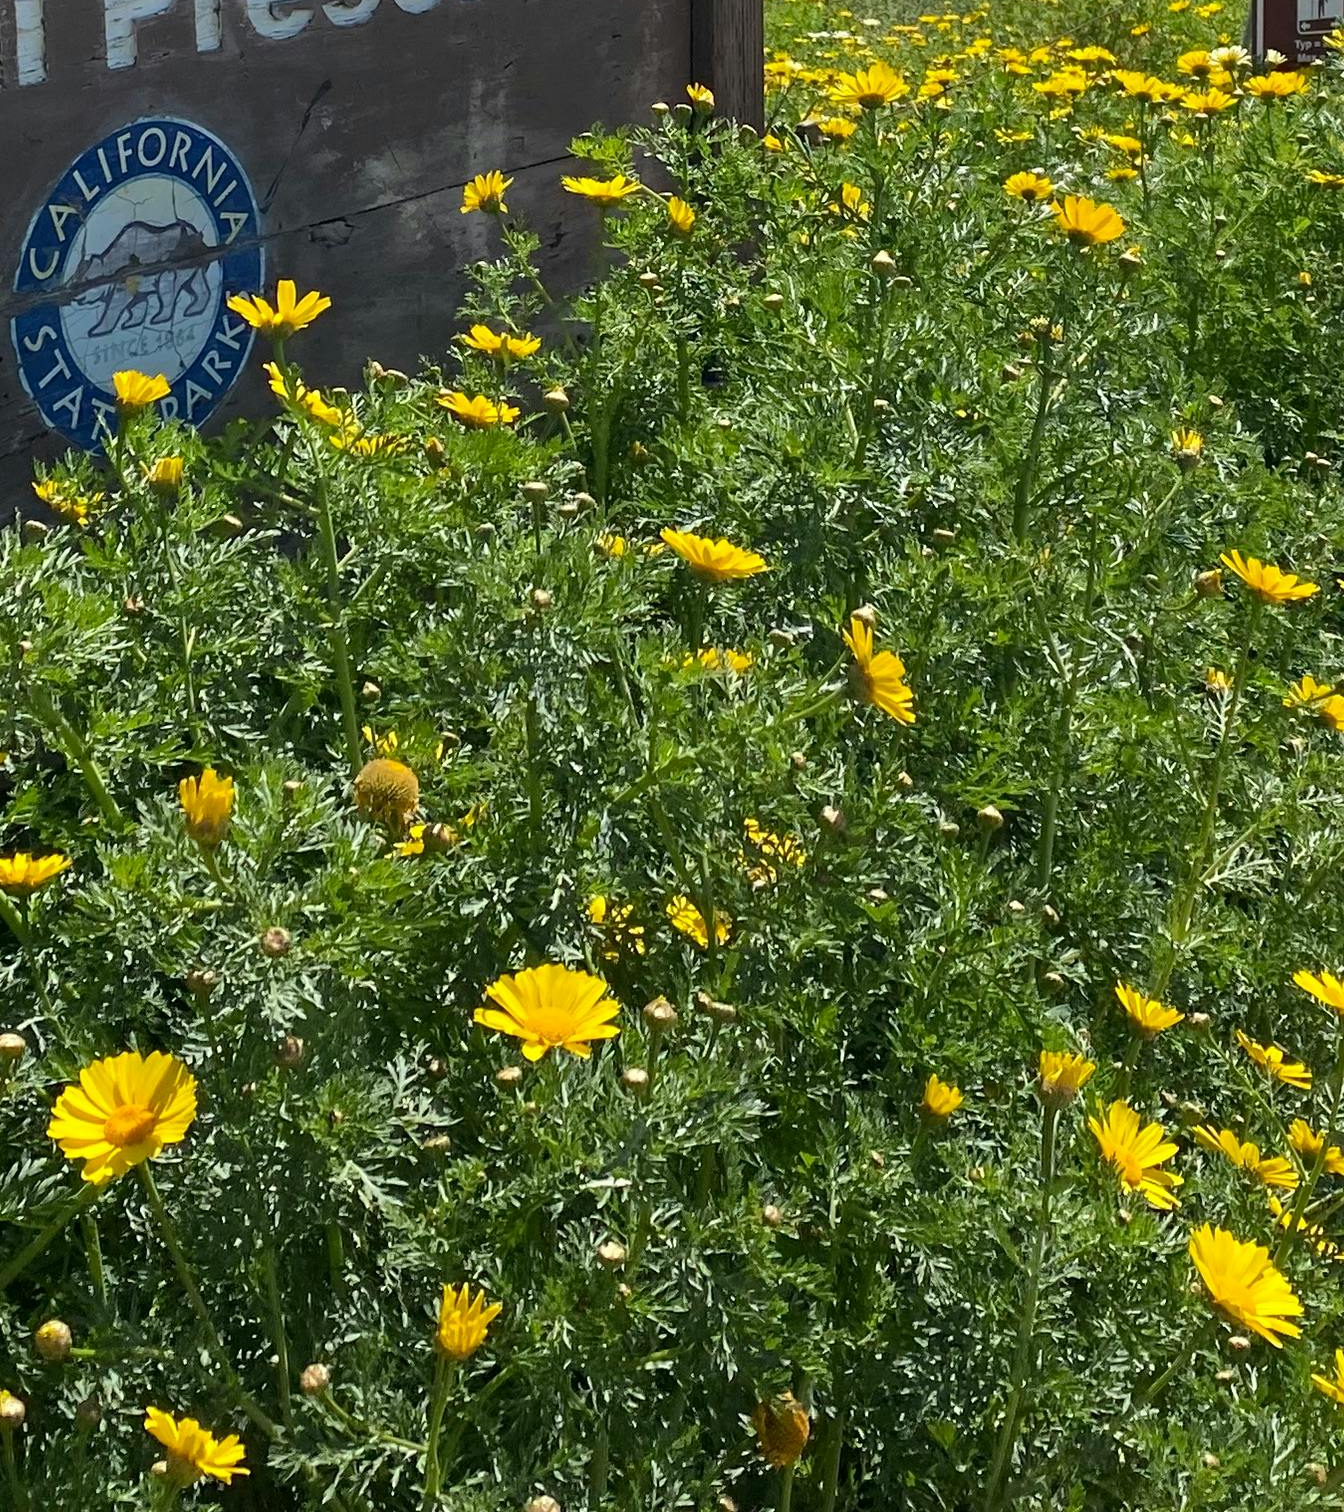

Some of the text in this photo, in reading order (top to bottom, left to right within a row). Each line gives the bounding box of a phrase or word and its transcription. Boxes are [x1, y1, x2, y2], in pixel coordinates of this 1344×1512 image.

[1294, 39, 1313, 52] Typ
[28, 127, 250, 281] CALIFORNIA
[22, 324, 118, 440] STAT
